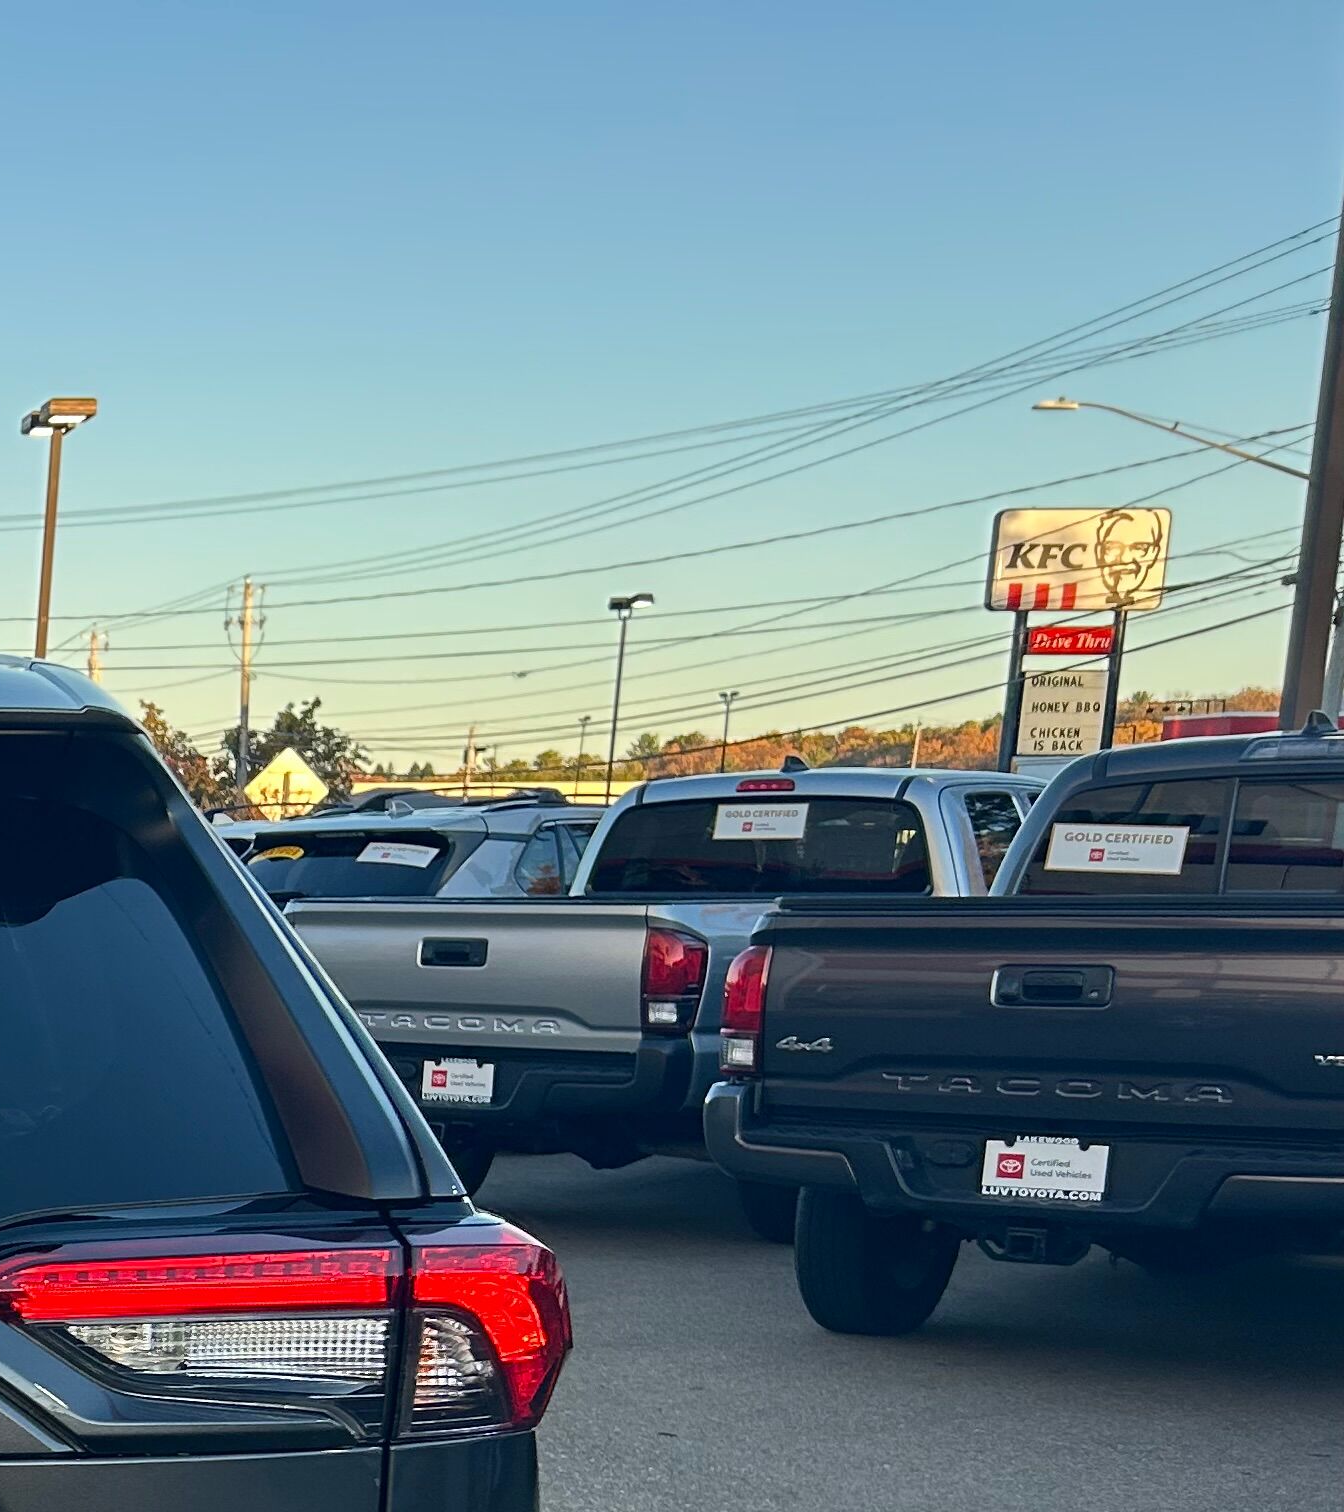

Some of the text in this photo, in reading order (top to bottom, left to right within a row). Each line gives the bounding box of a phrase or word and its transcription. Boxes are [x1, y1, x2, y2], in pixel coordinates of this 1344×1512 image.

[1005, 543, 1088, 569] KFC
[1032, 632, 1110, 649] Drive Thru
[1032, 676, 1084, 687] ORIGINAL
[1032, 702, 1101, 712] HONEY BBQ
[1030, 727, 1080, 739] CHICKEN
[1033, 740, 1083, 751] IS BACK
[725, 810, 799, 818] GOLD CERTIFIED
[1064, 832, 1174, 845] GOLD CERTIFIED
[359, 1012, 561, 1034] TACOMA
[775, 1036, 833, 1053] 4x4
[881, 1072, 1233, 1103] TACOMA
[1016, 1136, 1079, 1145] LAKEWOOD
[1031, 1158, 1071, 1168] Certified
[1055, 1170, 1092, 1179] Vehicles
[981, 1186, 1102, 1201] LUVTOYOTA.COM
